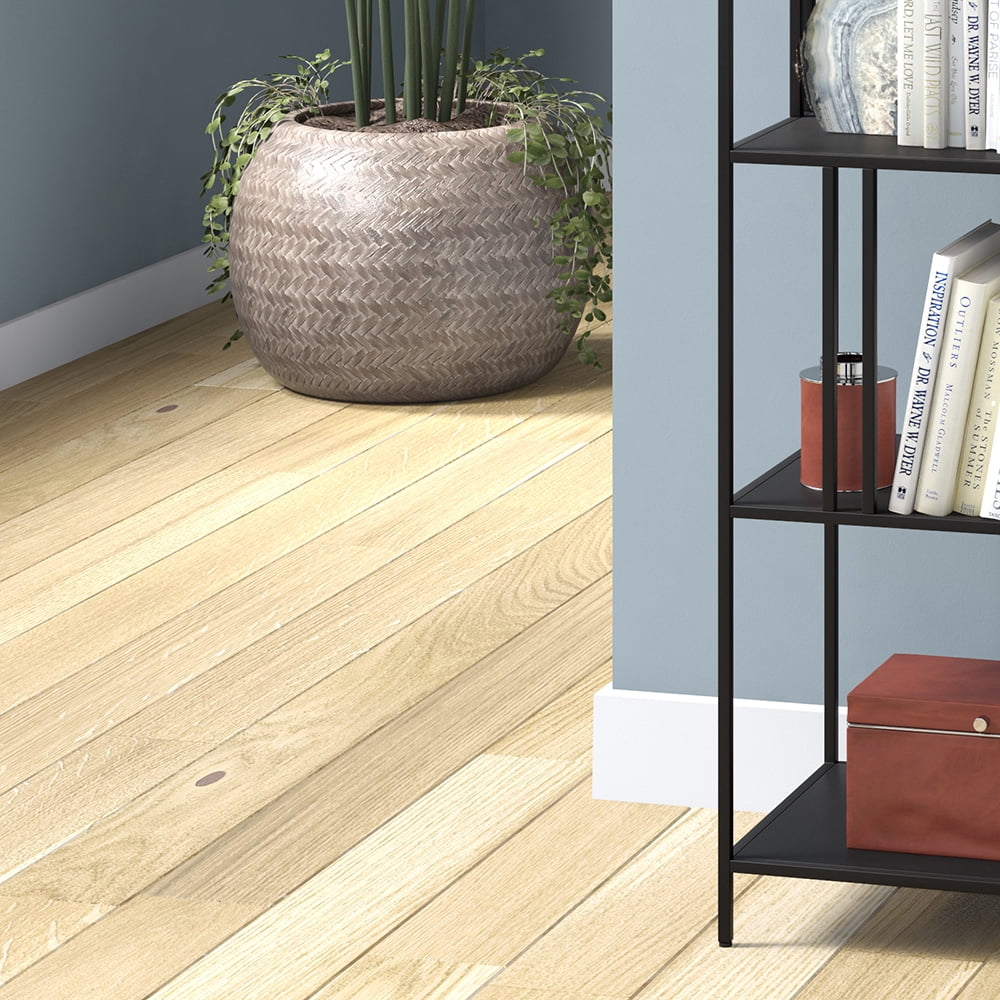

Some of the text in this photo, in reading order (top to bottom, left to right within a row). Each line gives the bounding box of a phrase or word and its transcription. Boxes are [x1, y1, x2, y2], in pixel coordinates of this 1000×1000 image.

[903, 20, 914, 42] LET
[967, 15, 979, 33] DR.
[990, 10, 1000, 30] OF
[903, 43, 914, 60] ME
[967, 35, 980, 72] WAYNE
[988, 33, 1000, 80] PARISE
[903, 62, 914, 91] LOVE
[968, 74, 980, 86] W.
[968, 87, 980, 116] DYER
[949, 296, 972, 370] OUTLIERS
[899, 271, 949, 477] INSPIRATION DR. WAYNE W. DYER
[983, 340, 1000, 401] MOSSMAN
[939, 383, 954, 426] MALCOLM
[975, 407, 982, 419] of
[931, 427, 946, 474] GLADWELL
[963, 424, 981, 488] SUMMER
[972, 410, 993, 491] The STONES
